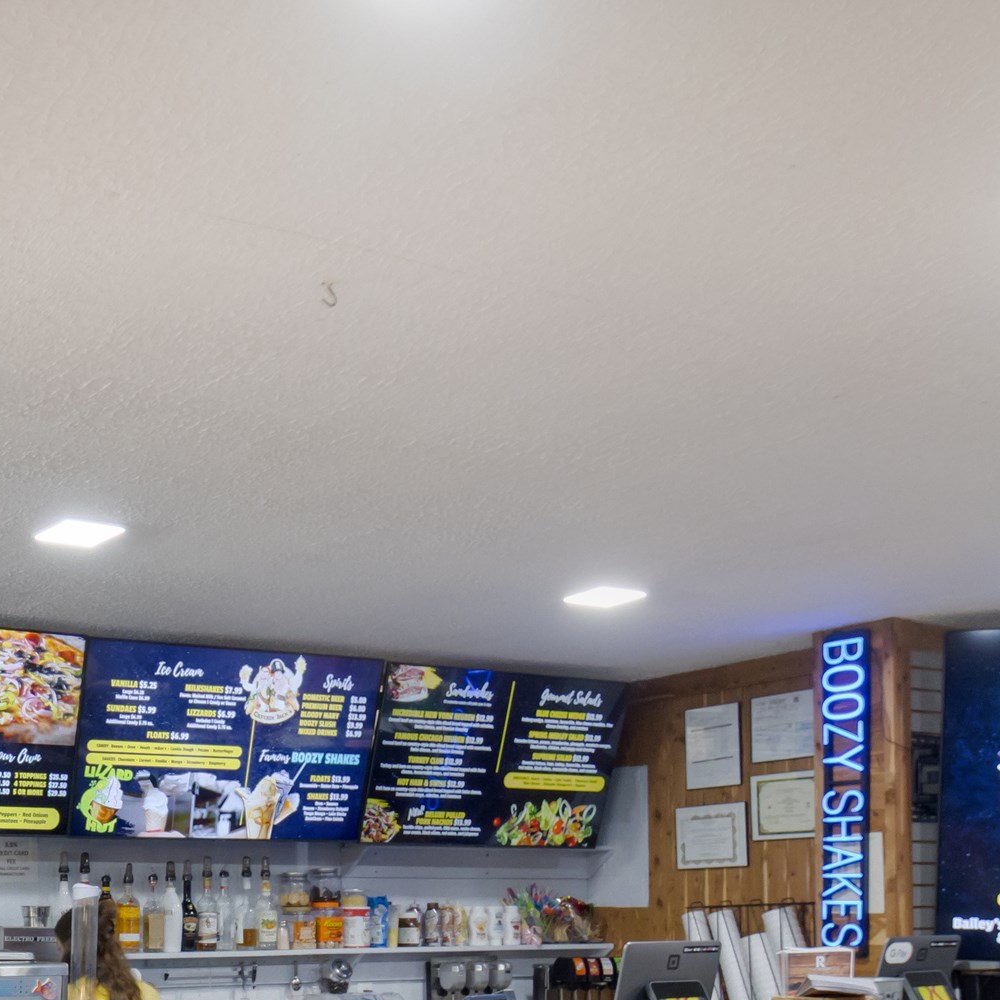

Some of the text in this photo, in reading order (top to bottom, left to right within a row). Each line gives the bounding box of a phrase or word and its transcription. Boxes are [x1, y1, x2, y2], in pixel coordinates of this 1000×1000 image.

[154, 661, 204, 678] Ice Cream
[111, 679, 138, 687] VANILLA
[185, 684, 243, 695] MILKSHAKES $7.99
[323, 673, 354, 693] Spirits
[106, 704, 157, 714] SUNDAES $5.99
[187, 708, 236, 719] LIZZARDS $6.99
[146, 731, 189, 740] FLOATS $6.99
[17, 748, 42, 764] Own
[258, 749, 360, 765] Famous BOOZY SHAKES
[19, 772, 47, 780] TOPPINGS
[821, 636, 865, 947] BOOZY SHAKES
[85, 818, 117, 833] HUT
[952, 917, 1000, 932] Bailey'
